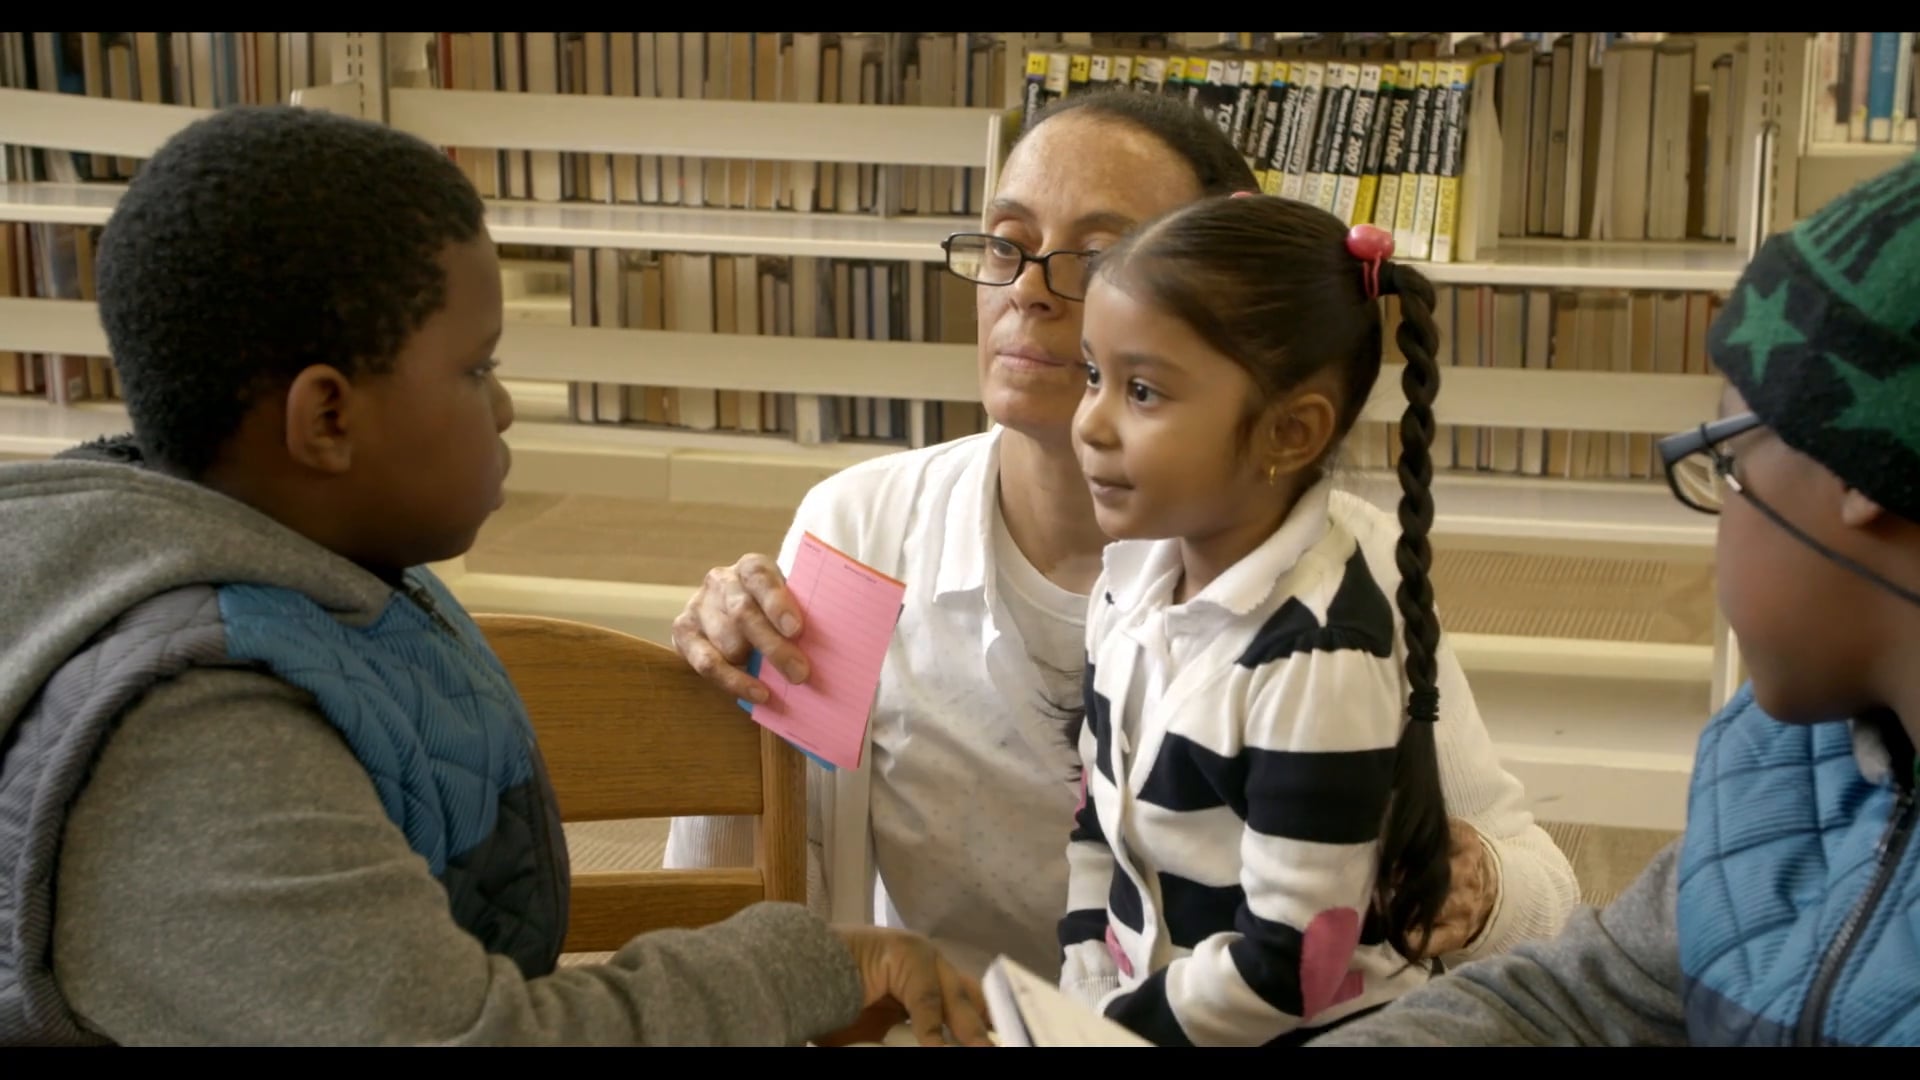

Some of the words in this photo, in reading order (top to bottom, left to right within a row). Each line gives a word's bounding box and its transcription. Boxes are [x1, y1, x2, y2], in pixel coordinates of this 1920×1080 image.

[1352, 97, 1371, 135] Word
[1418, 89, 1429, 107] The
[1435, 89, 1447, 107] The
[1270, 88, 1299, 169] Trigonometry
[1289, 91, 1316, 174] Trigonometry
[1384, 99, 1409, 168] YouTube
[1344, 136, 1363, 173] 2007
